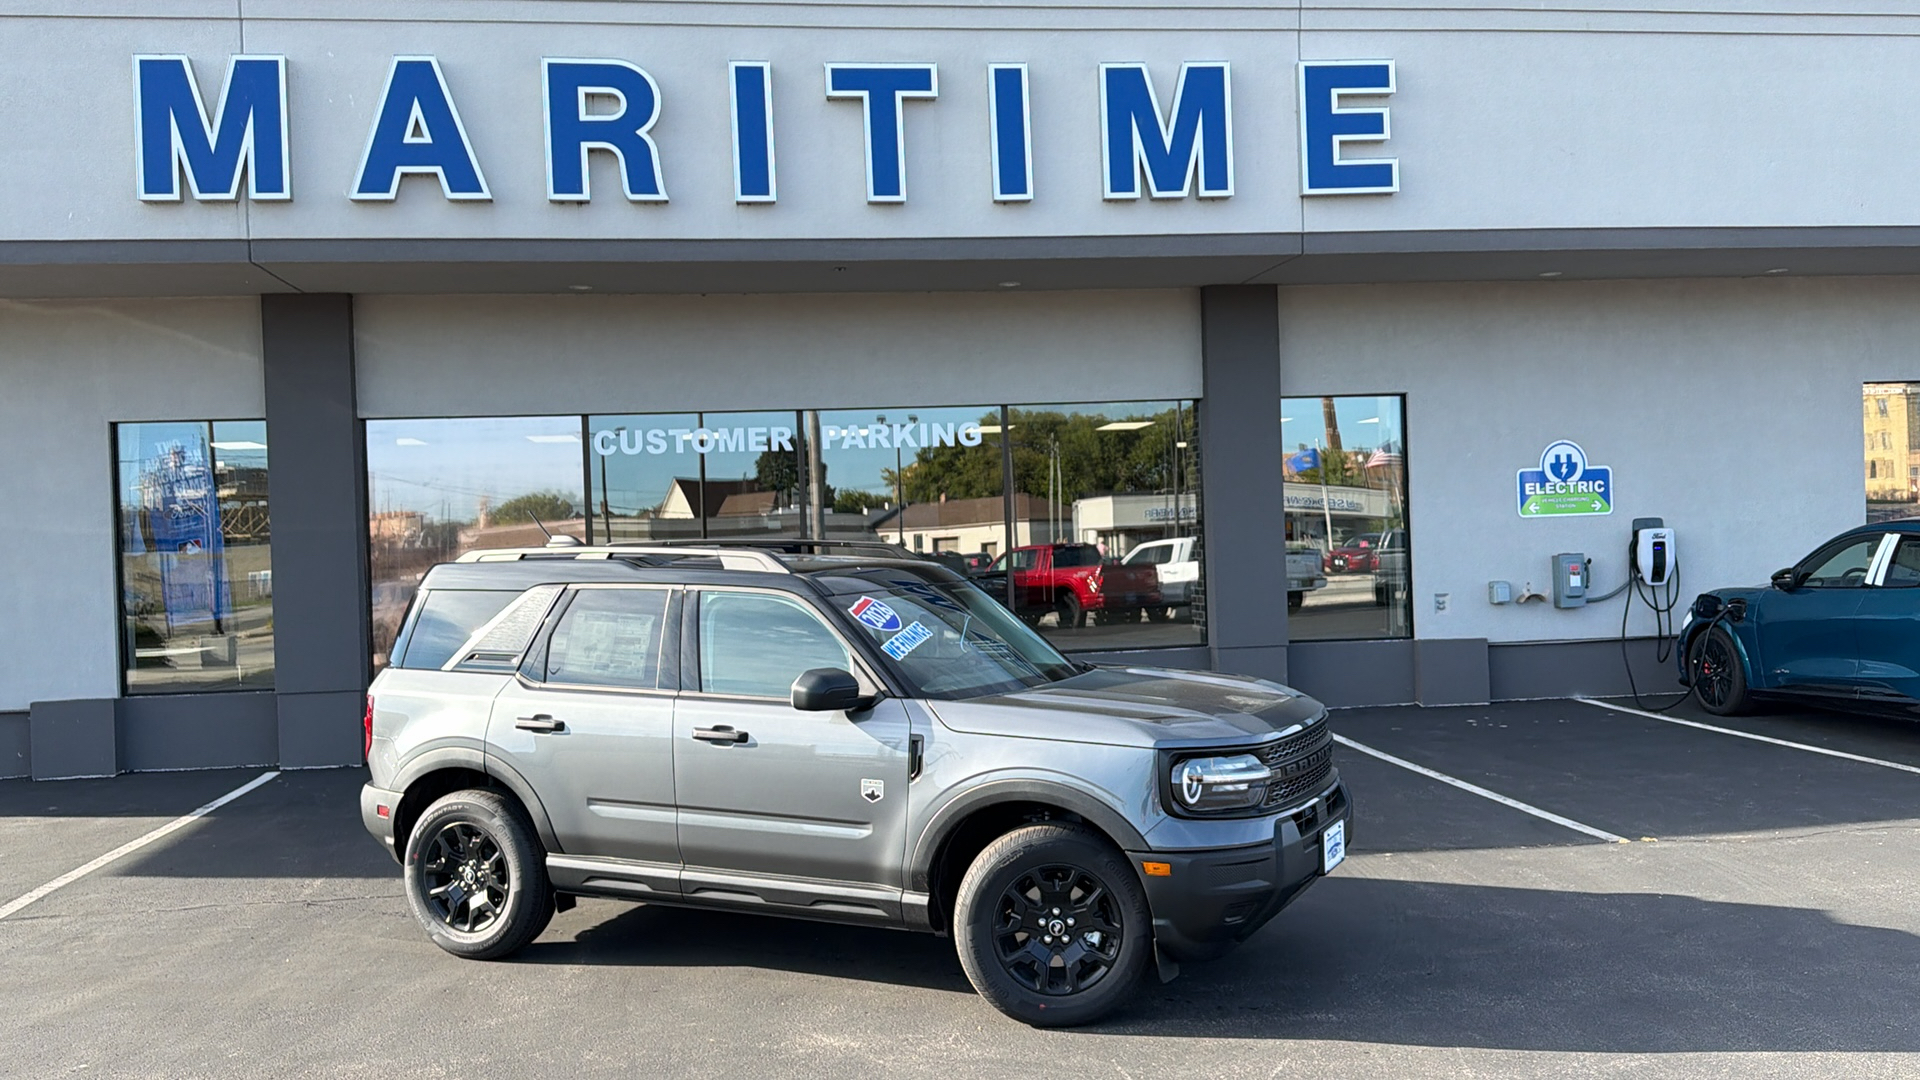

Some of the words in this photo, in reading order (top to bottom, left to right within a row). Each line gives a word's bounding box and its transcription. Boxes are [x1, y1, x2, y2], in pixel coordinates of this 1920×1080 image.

[132, 54, 1399, 204] MARITIME
[593, 426, 794, 456] CUSTOMER
[821, 421, 982, 450] PARKING
[1525, 480, 1605, 495] ELECTRIC
[862, 602, 894, 628] 2026
[1285, 745, 1333, 775] BRON
